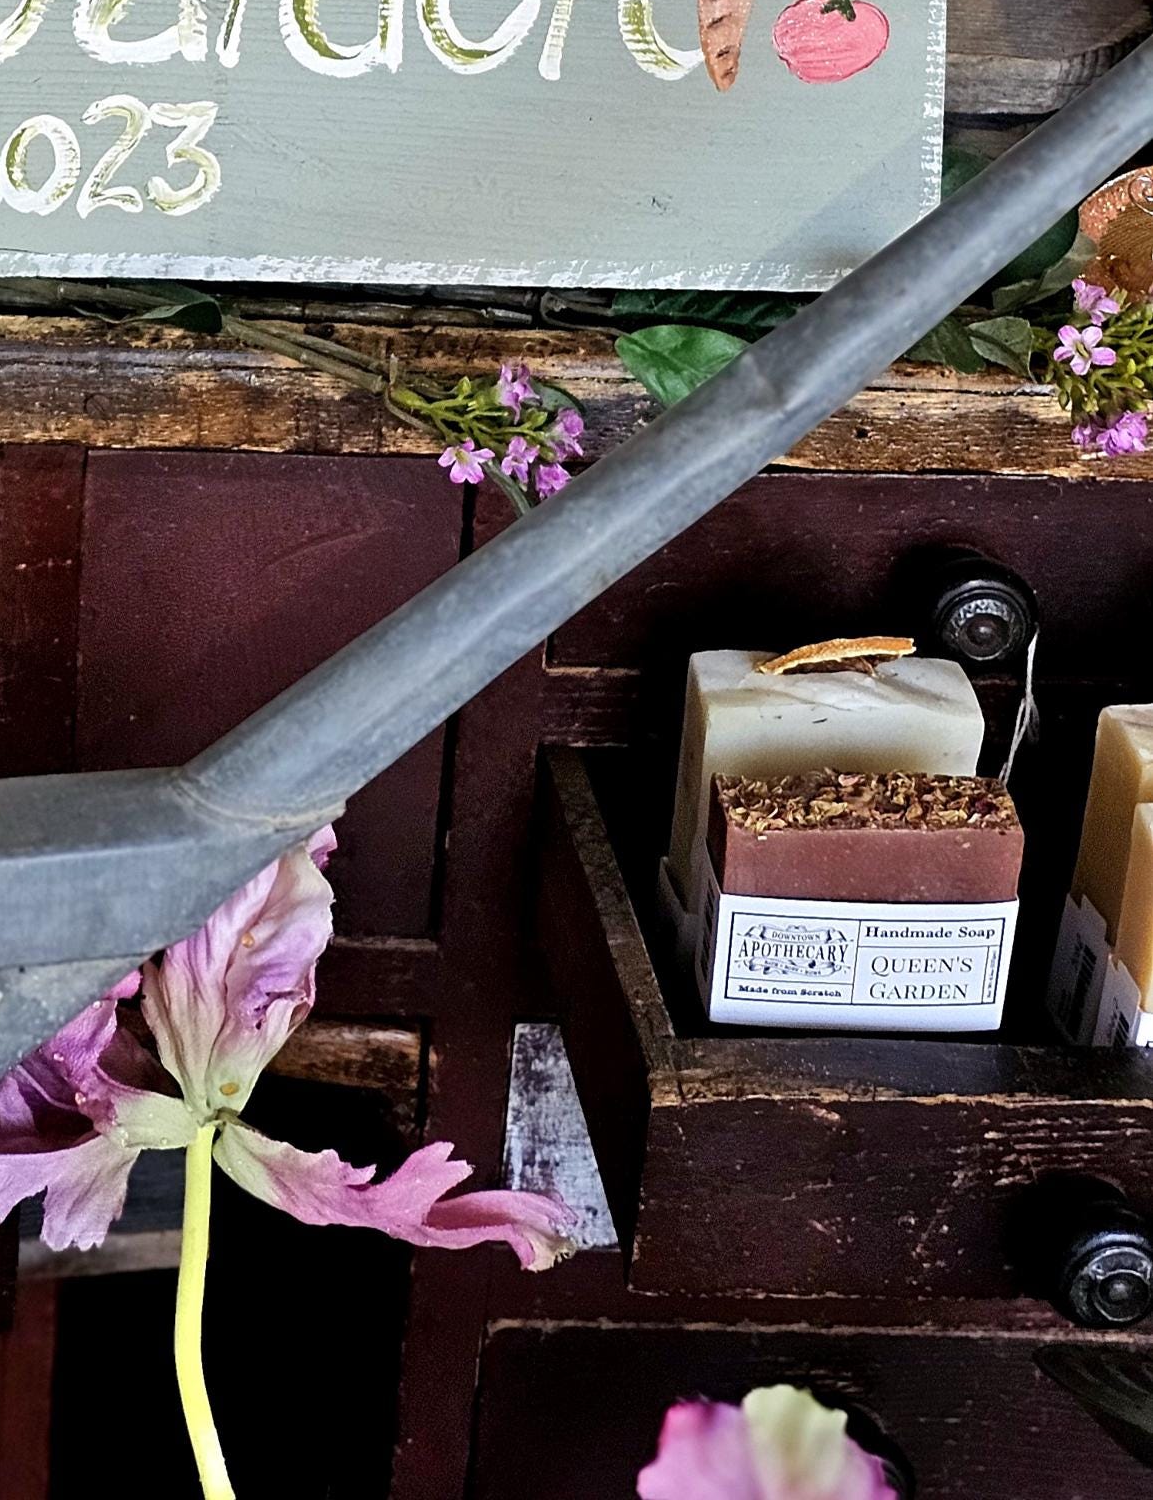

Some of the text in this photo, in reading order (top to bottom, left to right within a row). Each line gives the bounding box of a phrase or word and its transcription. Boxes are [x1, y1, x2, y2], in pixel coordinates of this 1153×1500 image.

[771, 931, 821, 941] DOWNTOWN
[864, 926, 996, 939] Handmade Soap
[738, 939, 849, 963] APOTHECARY
[871, 956, 973, 977] QUEEN'S
[738, 984, 842, 998] Made from Scratch
[869, 982, 969, 1000] GARDEN
